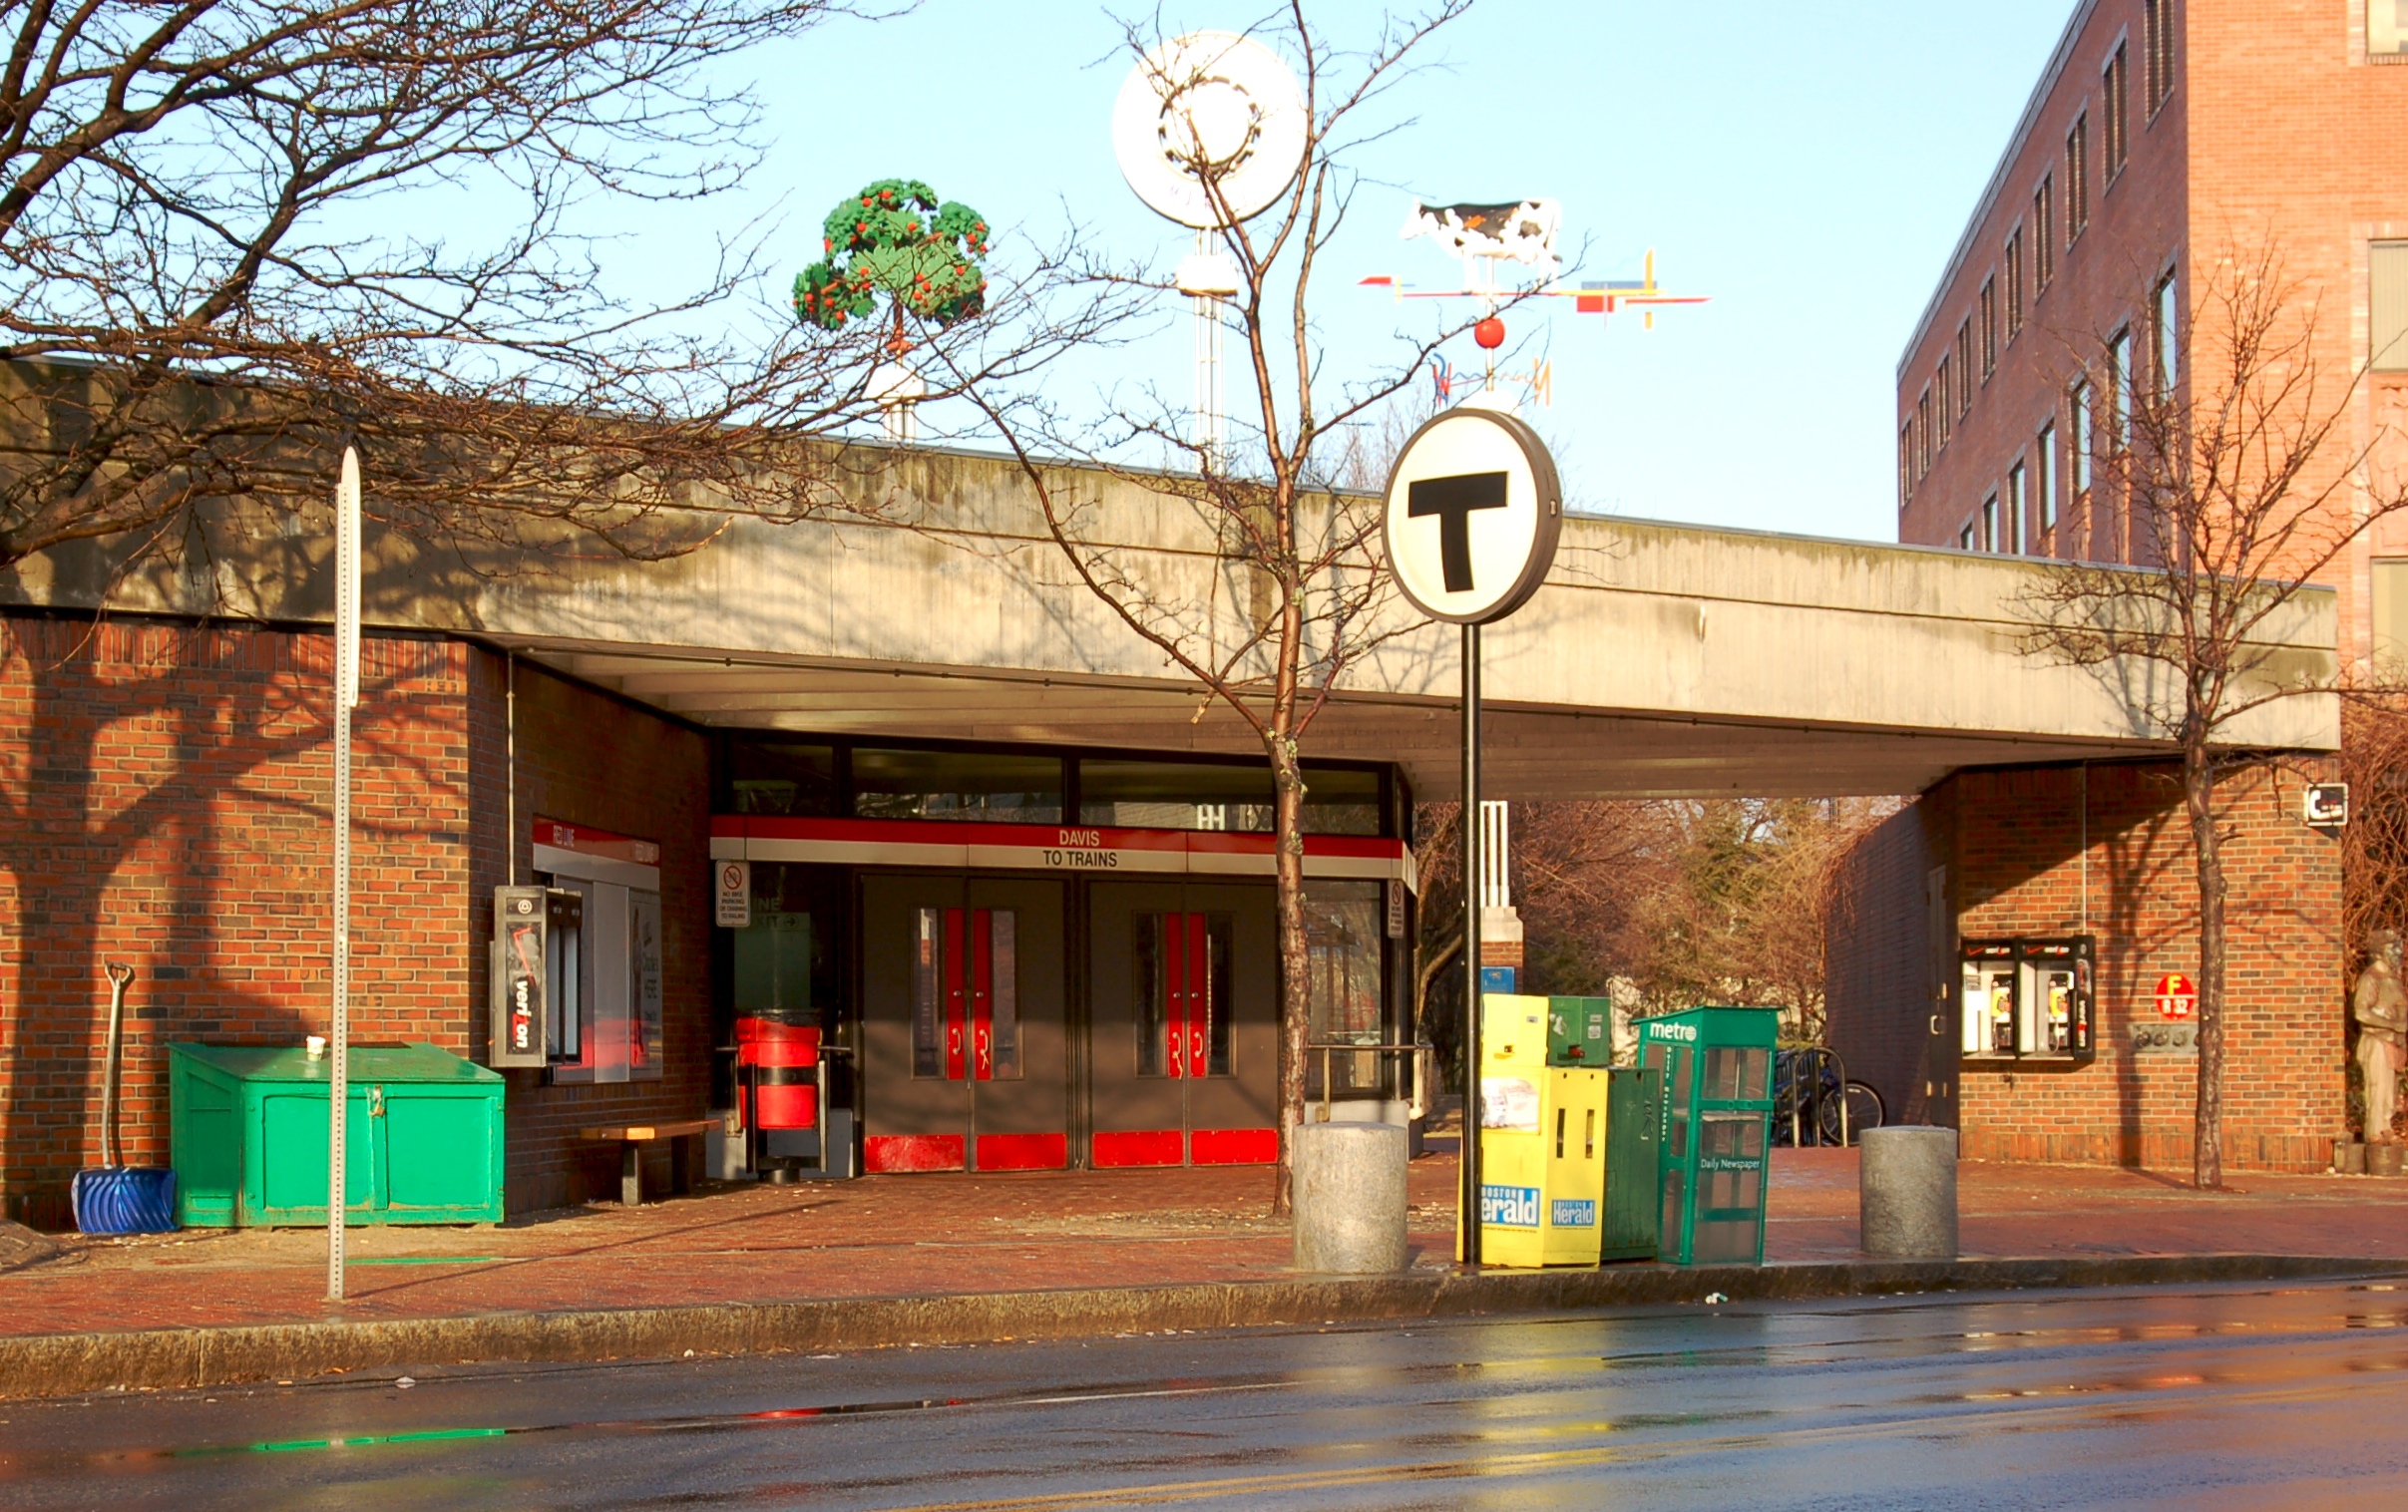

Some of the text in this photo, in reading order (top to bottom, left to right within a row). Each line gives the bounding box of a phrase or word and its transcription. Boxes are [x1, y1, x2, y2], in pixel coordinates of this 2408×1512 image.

[1407, 471, 1509, 593] T
[553, 824, 563, 845] RED
[1059, 830, 1100, 847] DAVIS
[1042, 850, 1117, 868] TO TRAINS
[2168, 975, 2183, 995] F
[513, 980, 532, 1048] verizon
[2163, 998, 2189, 1014] R 32
[1650, 1021, 1697, 1042] metro
[1700, 1157, 1761, 1171] Daily Newspaper
[1481, 1188, 1538, 1225] erald
[1553, 1201, 1593, 1225] Herald
